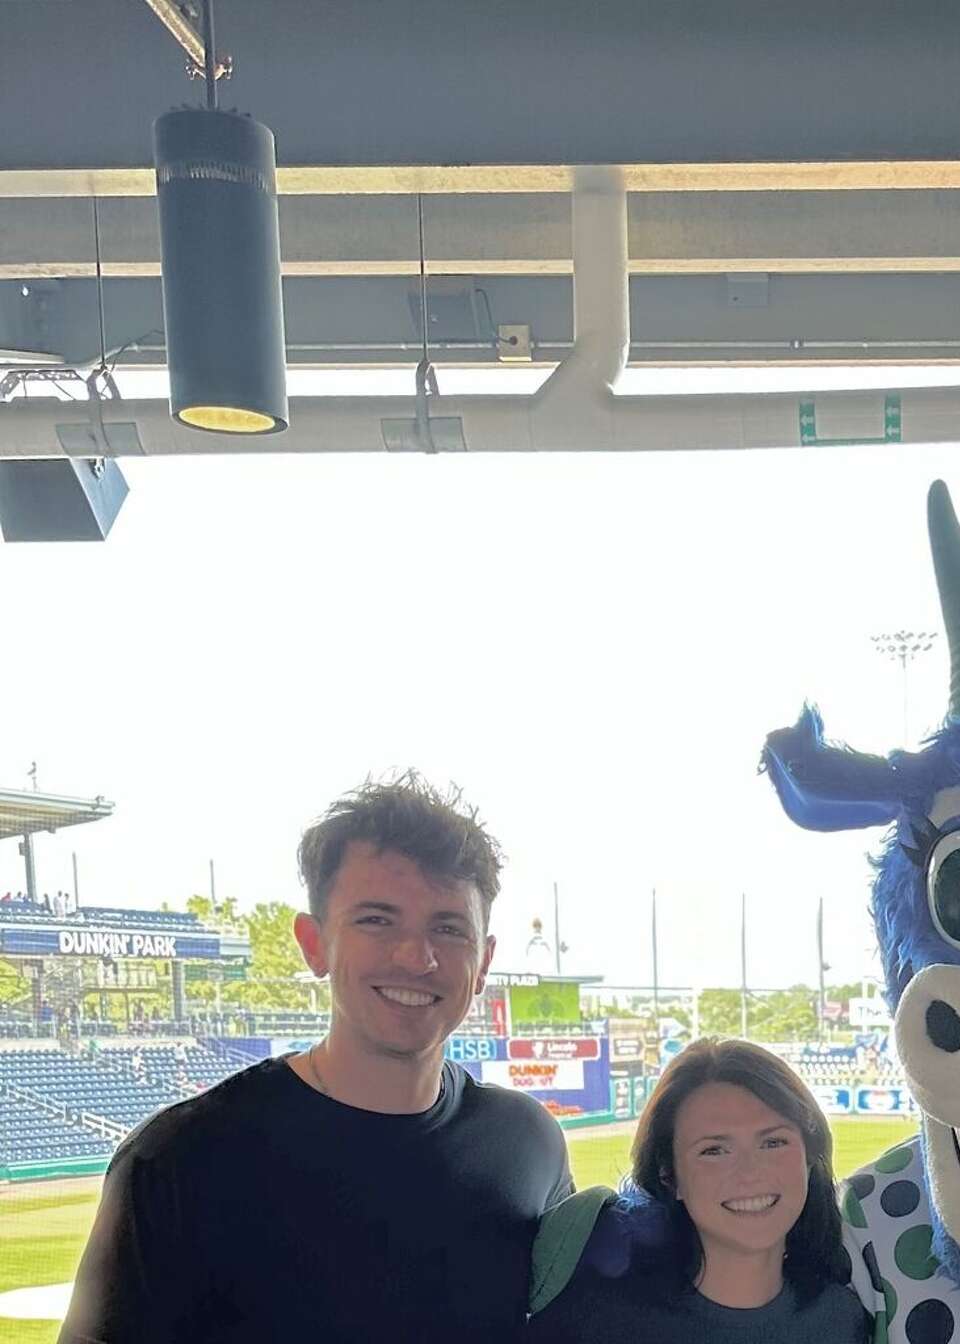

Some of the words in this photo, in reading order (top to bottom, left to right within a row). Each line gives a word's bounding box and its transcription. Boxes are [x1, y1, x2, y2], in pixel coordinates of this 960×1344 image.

[59, 931, 130, 956] DUNKIN'
[133, 935, 177, 957] PARK
[450, 1039, 491, 1060] HSB
